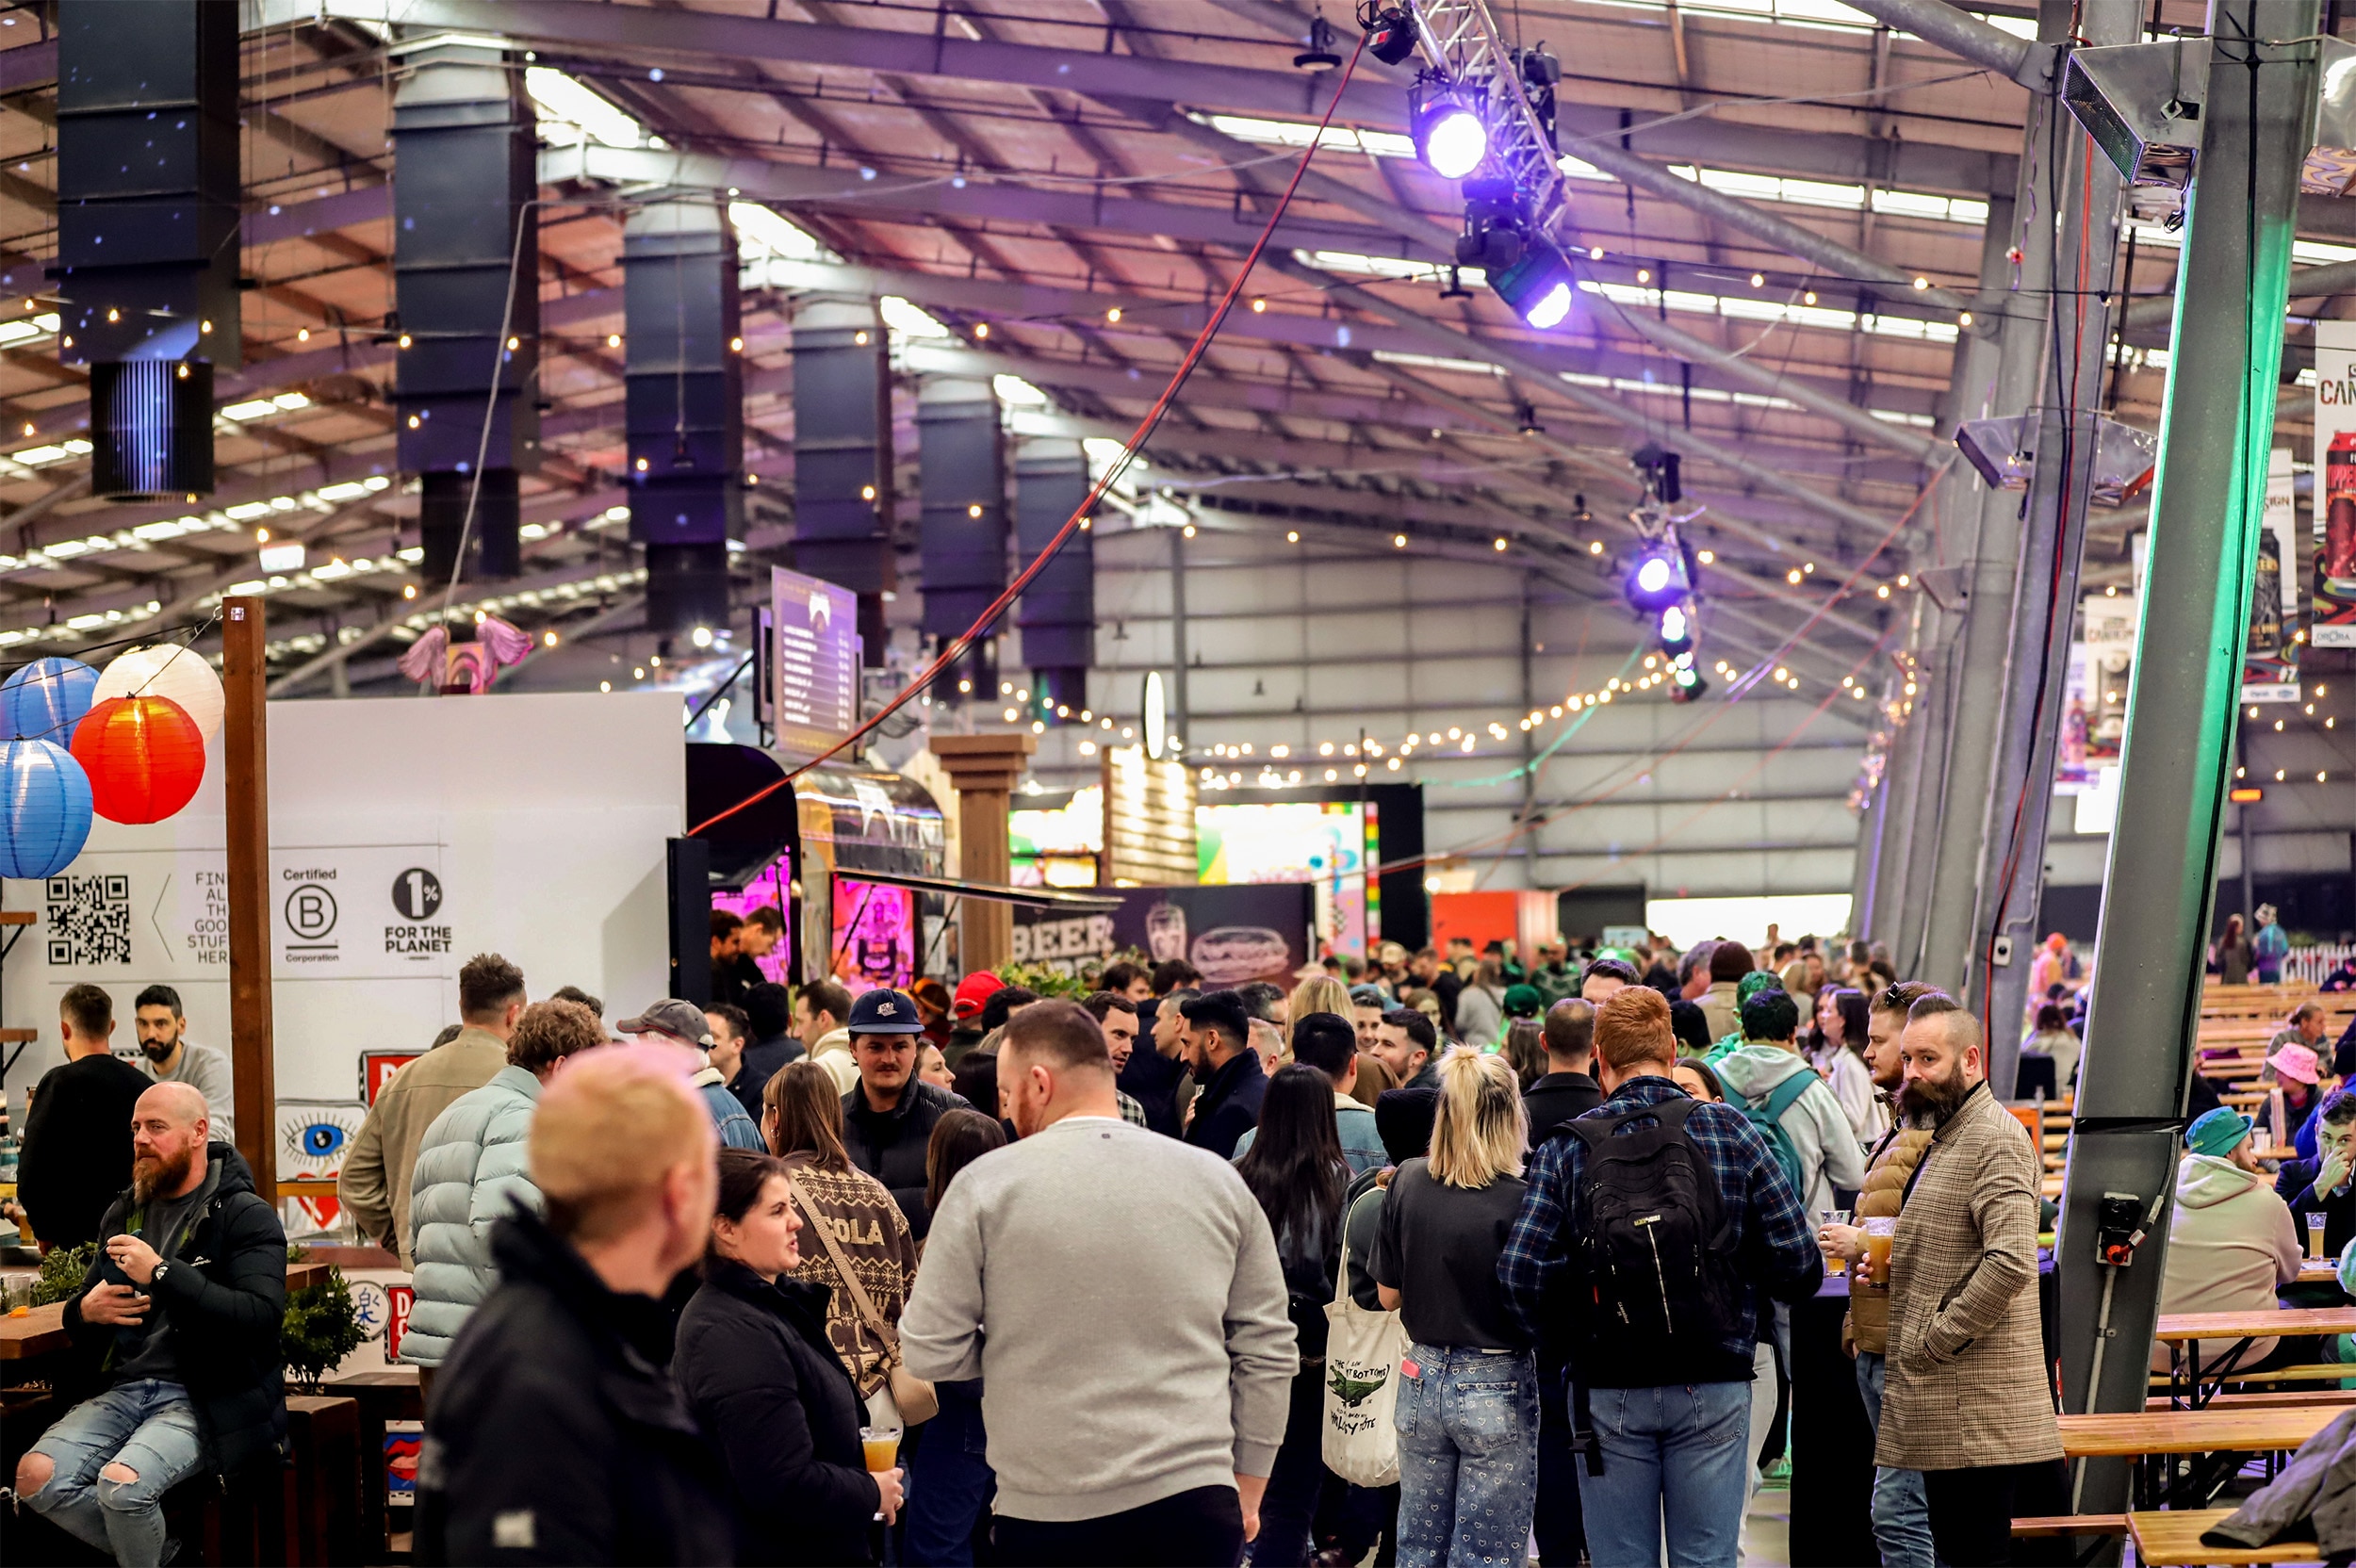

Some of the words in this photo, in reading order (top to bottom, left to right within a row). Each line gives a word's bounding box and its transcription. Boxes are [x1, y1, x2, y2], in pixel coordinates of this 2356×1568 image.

[2264, 496, 2290, 512] SIGN
[196, 872, 225, 885] FIN
[283, 869, 336, 881] Certified
[206, 889, 225, 901] AL
[206, 904, 226, 917] TH
[300, 896, 324, 928] B
[194, 919, 227, 933] GOO
[385, 927, 417, 939] FOR
[421, 926, 451, 939] THE
[188, 935, 227, 948] STUF
[1013, 913, 1115, 962] BEER
[385, 940, 451, 953] PLANET
[198, 950, 227, 964] HER
[286, 954, 339, 963] Corporation
